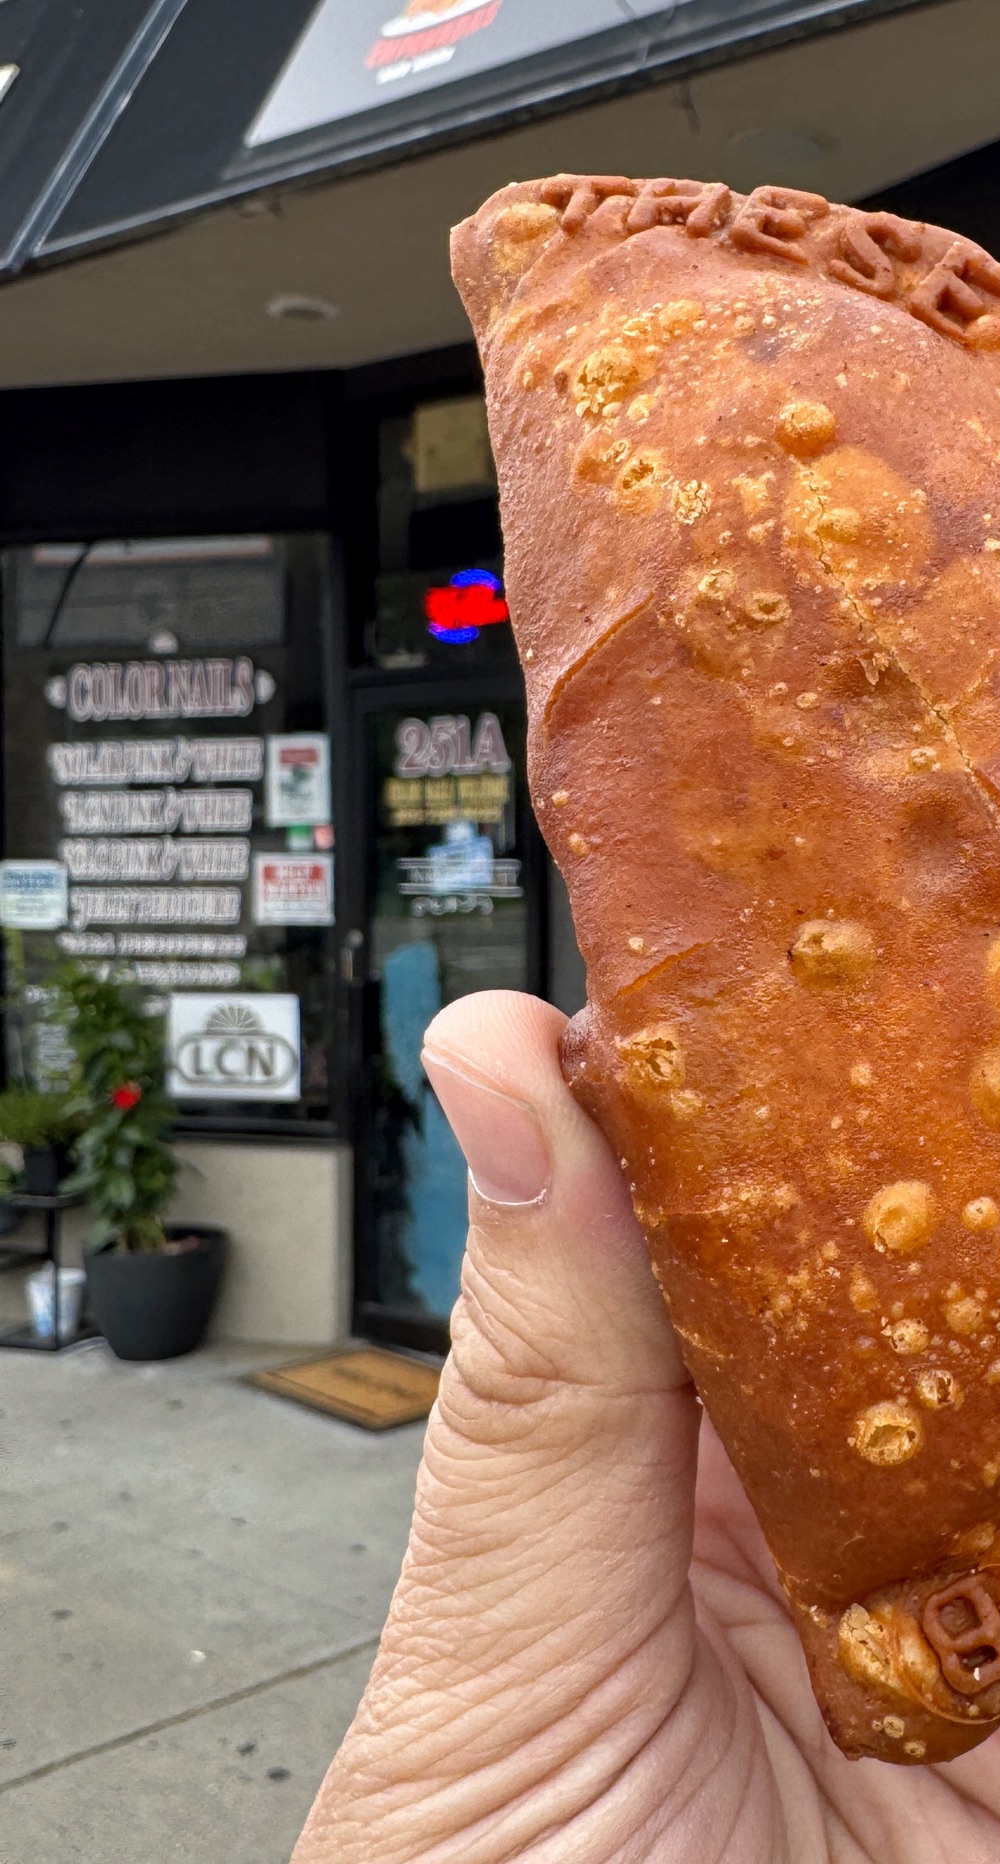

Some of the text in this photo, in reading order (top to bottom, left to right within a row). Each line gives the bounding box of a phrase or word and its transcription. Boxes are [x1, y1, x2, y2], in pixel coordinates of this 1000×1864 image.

[67, 655, 255, 722] COLOR NAILS
[393, 711, 511, 778] 251A
[189, 1041, 276, 1078] LCN
